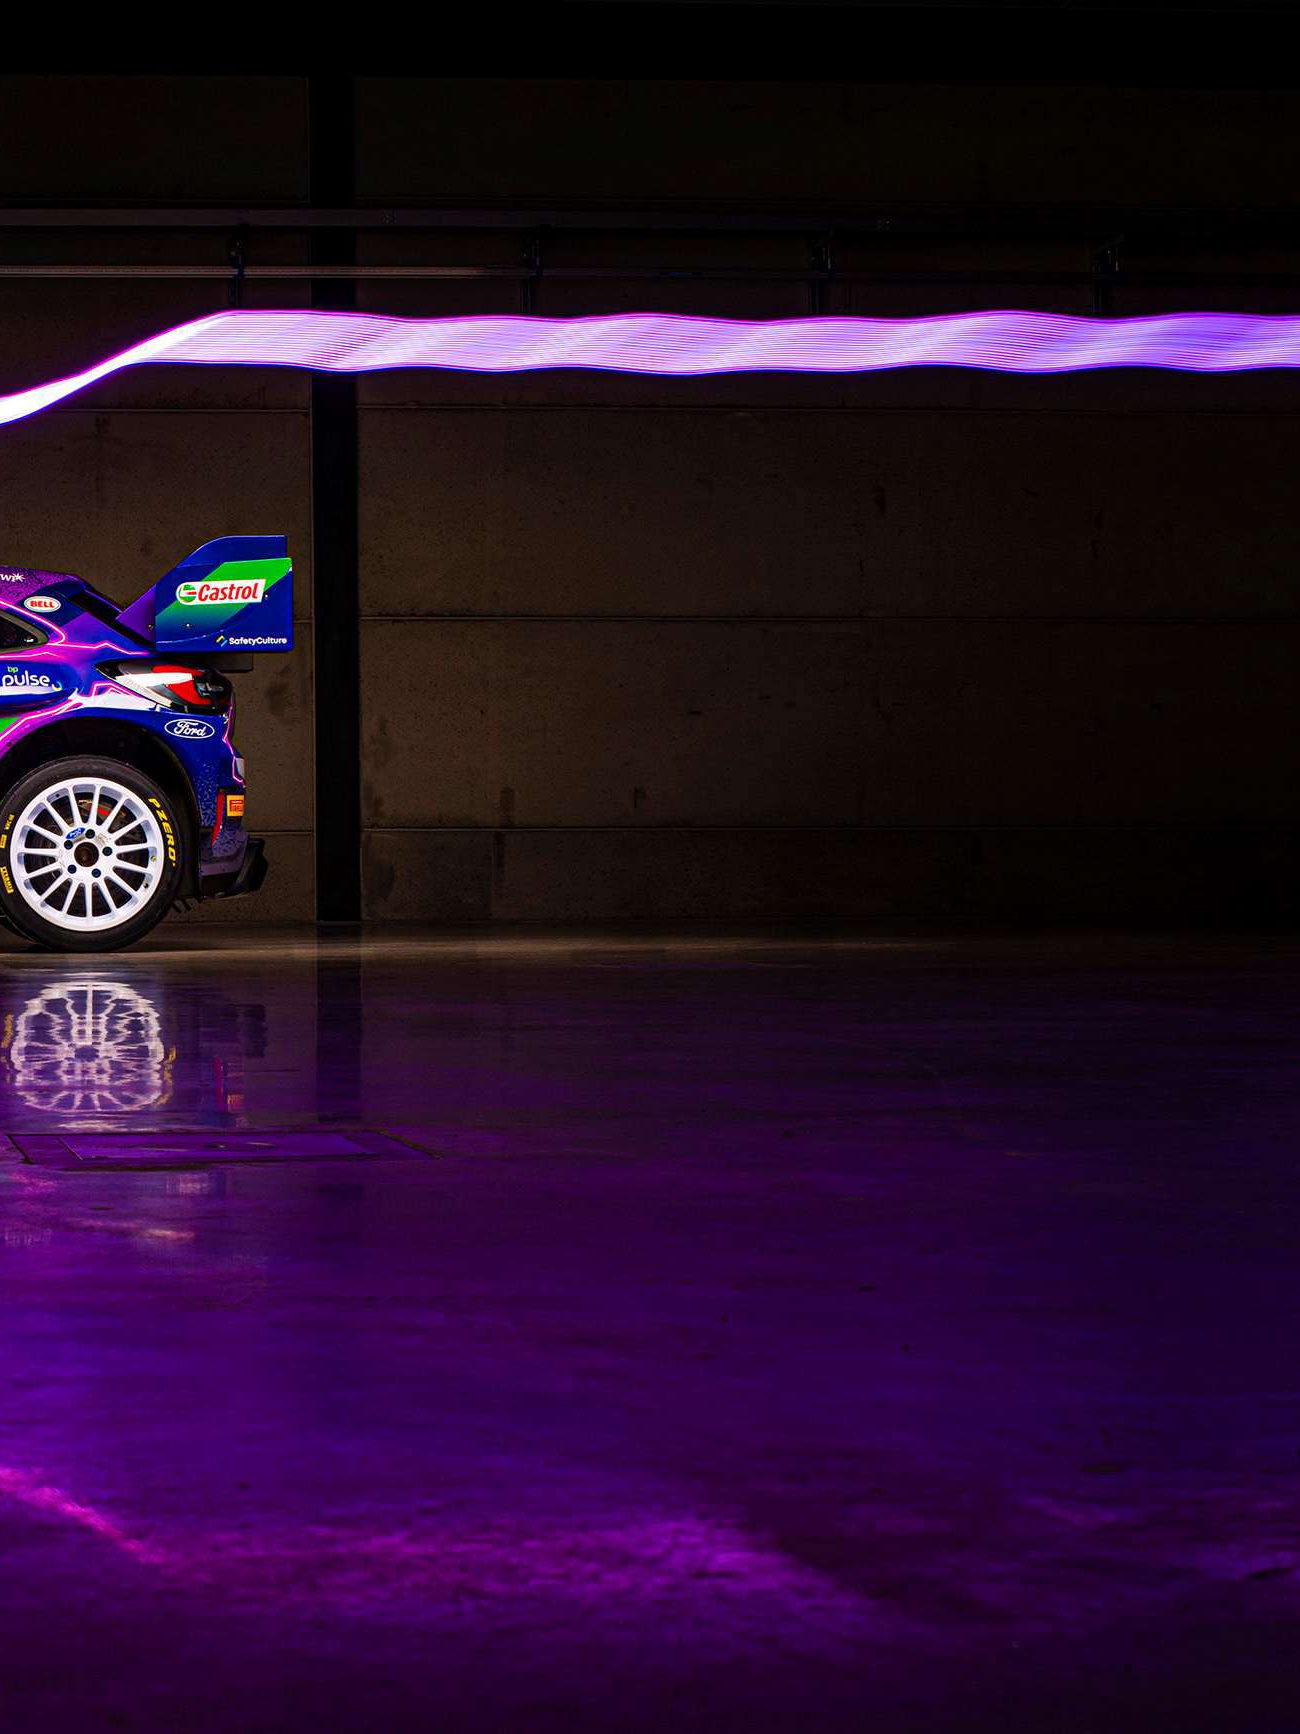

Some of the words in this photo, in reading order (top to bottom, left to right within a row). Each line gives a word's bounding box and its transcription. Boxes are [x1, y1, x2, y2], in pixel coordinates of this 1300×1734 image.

[197, 582, 259, 602] Castrol
[30, 600, 55, 608] BELL
[229, 636, 288, 646] SafetyCulture
[2, 670, 50, 687] pulse
[173, 720, 206, 737] Ford
